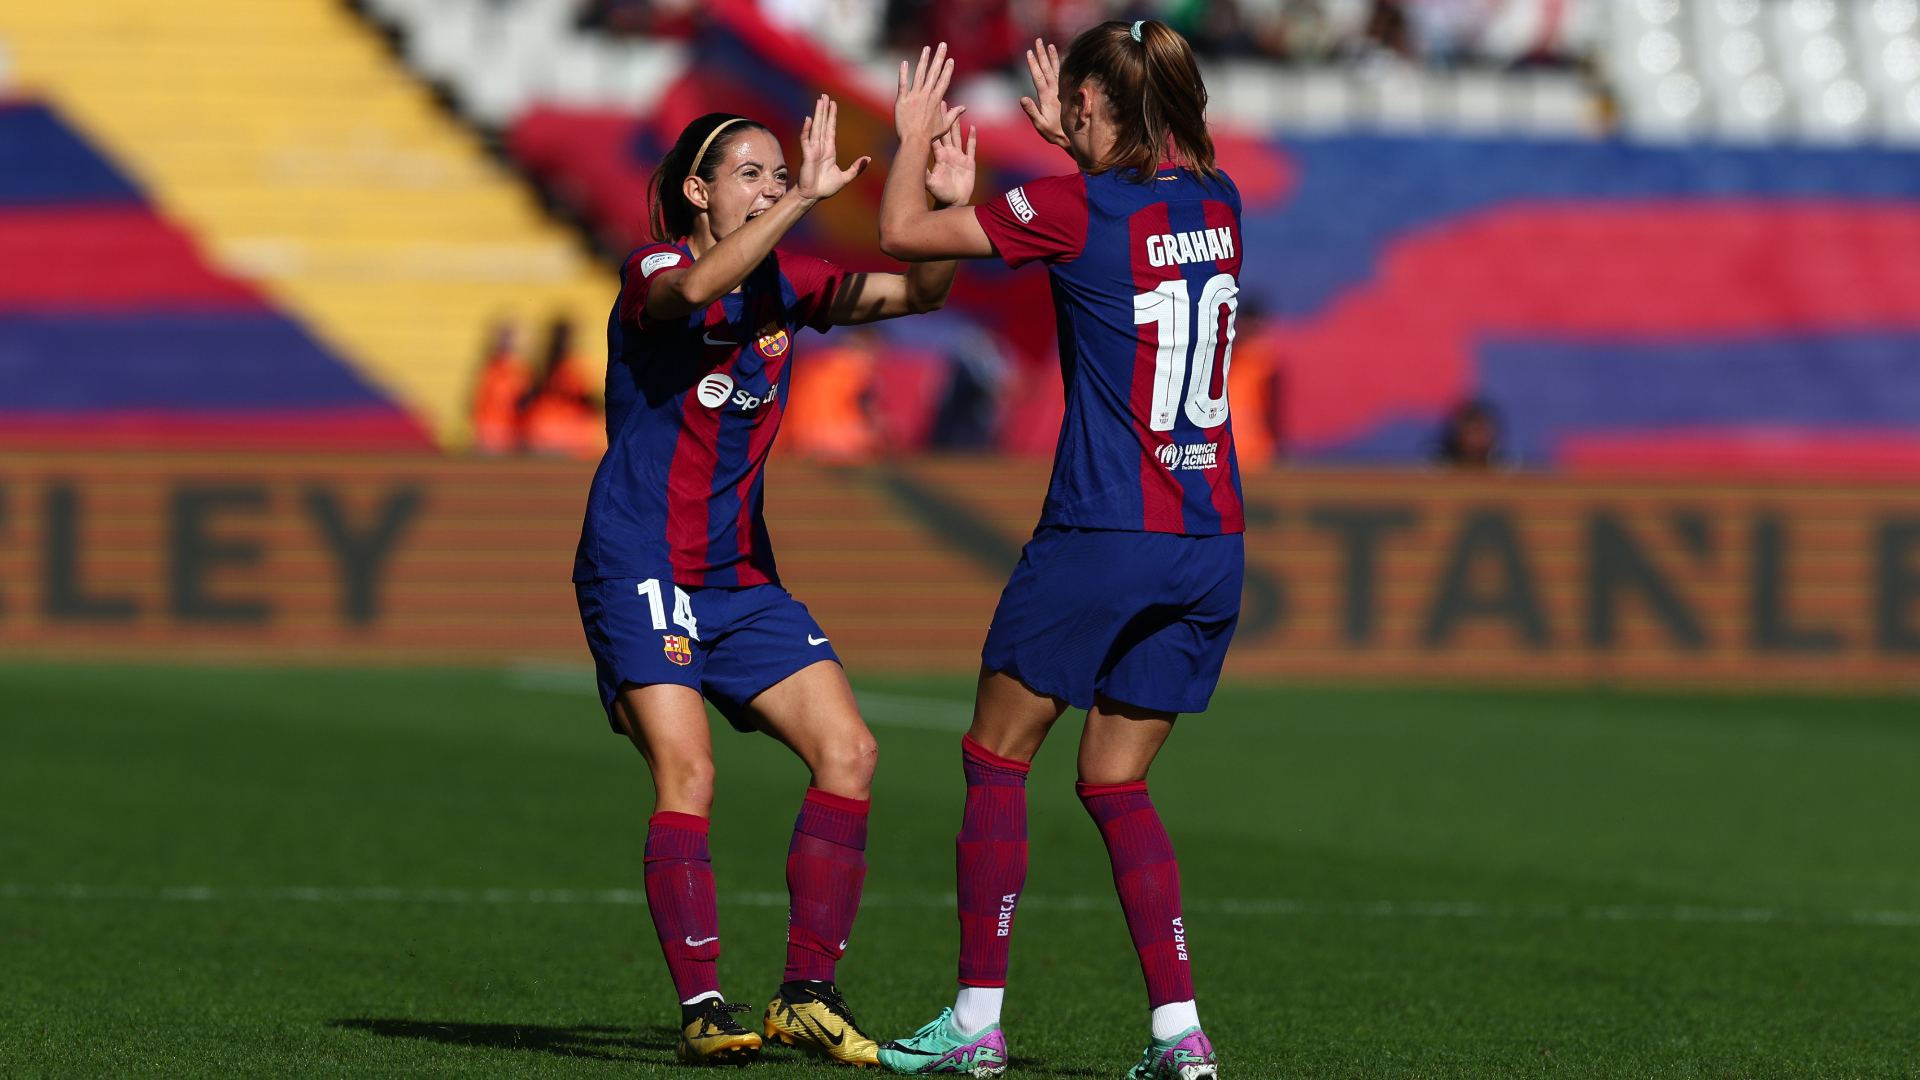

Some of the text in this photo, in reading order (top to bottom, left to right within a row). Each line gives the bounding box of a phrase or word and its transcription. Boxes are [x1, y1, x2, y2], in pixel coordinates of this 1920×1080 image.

[1146, 226, 1235, 268] GRAHAM
[1133, 273, 1239, 432] 10
[1181, 452, 1216, 466] ACNUR
[1184, 442, 1218, 455] UNHCR
[0, 479, 428, 628] LEY
[637, 578, 700, 642] 14
